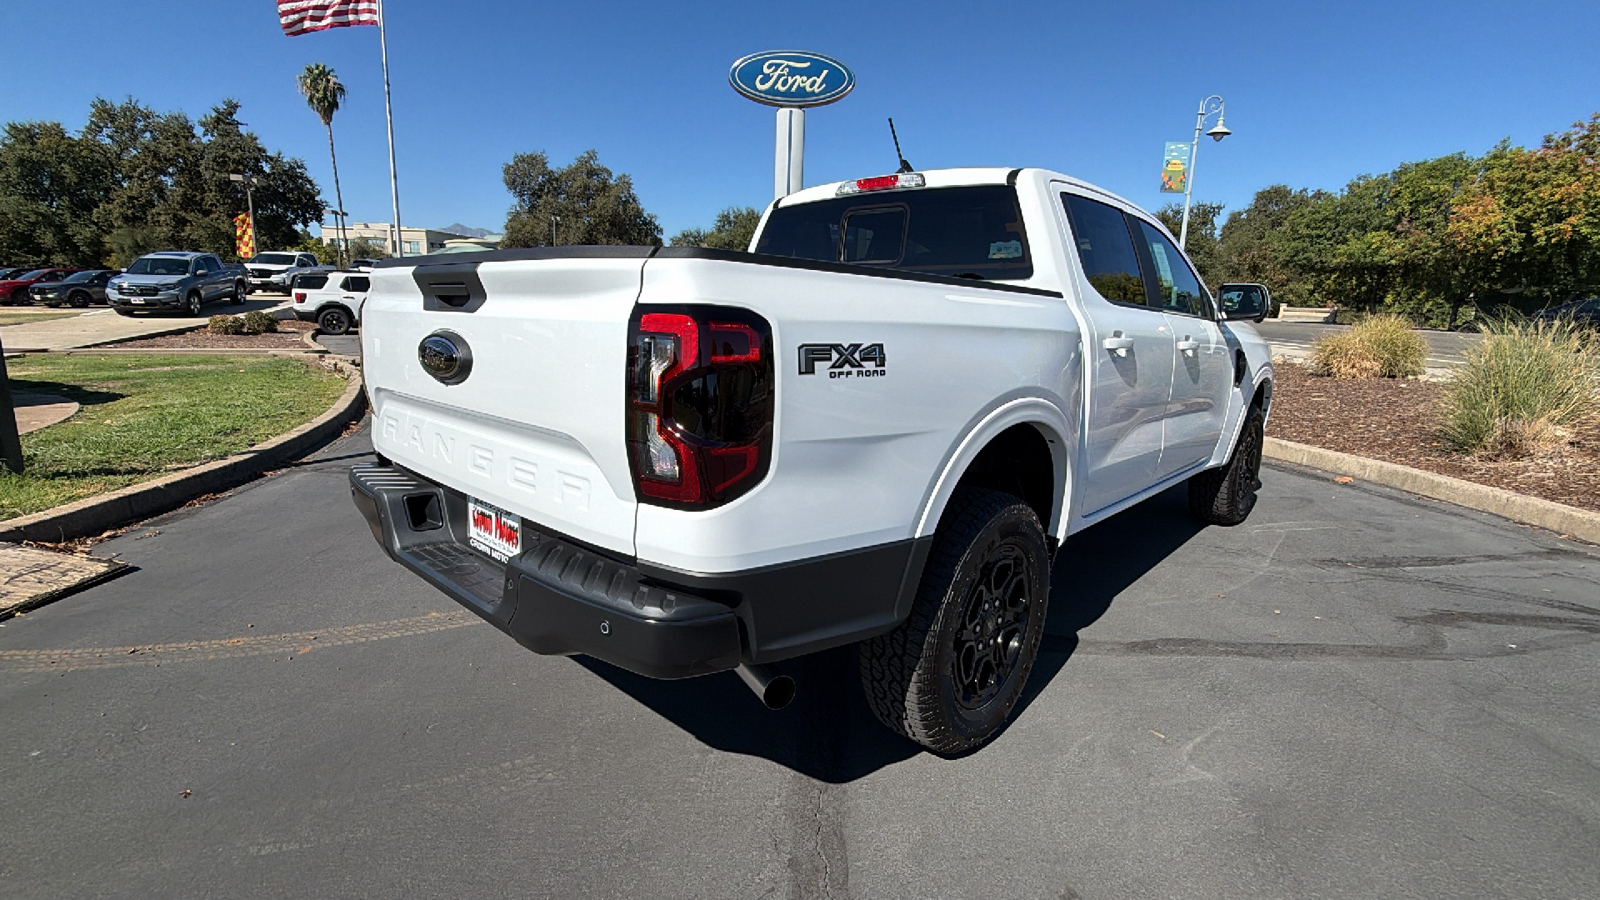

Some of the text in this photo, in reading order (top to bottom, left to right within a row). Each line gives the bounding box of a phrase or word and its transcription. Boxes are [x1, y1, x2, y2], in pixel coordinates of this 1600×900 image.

[755, 59, 829, 93] Ford
[797, 343, 887, 375] FX4
[856, 369, 886, 377] ROAD
[382, 414, 592, 512] RANGER
